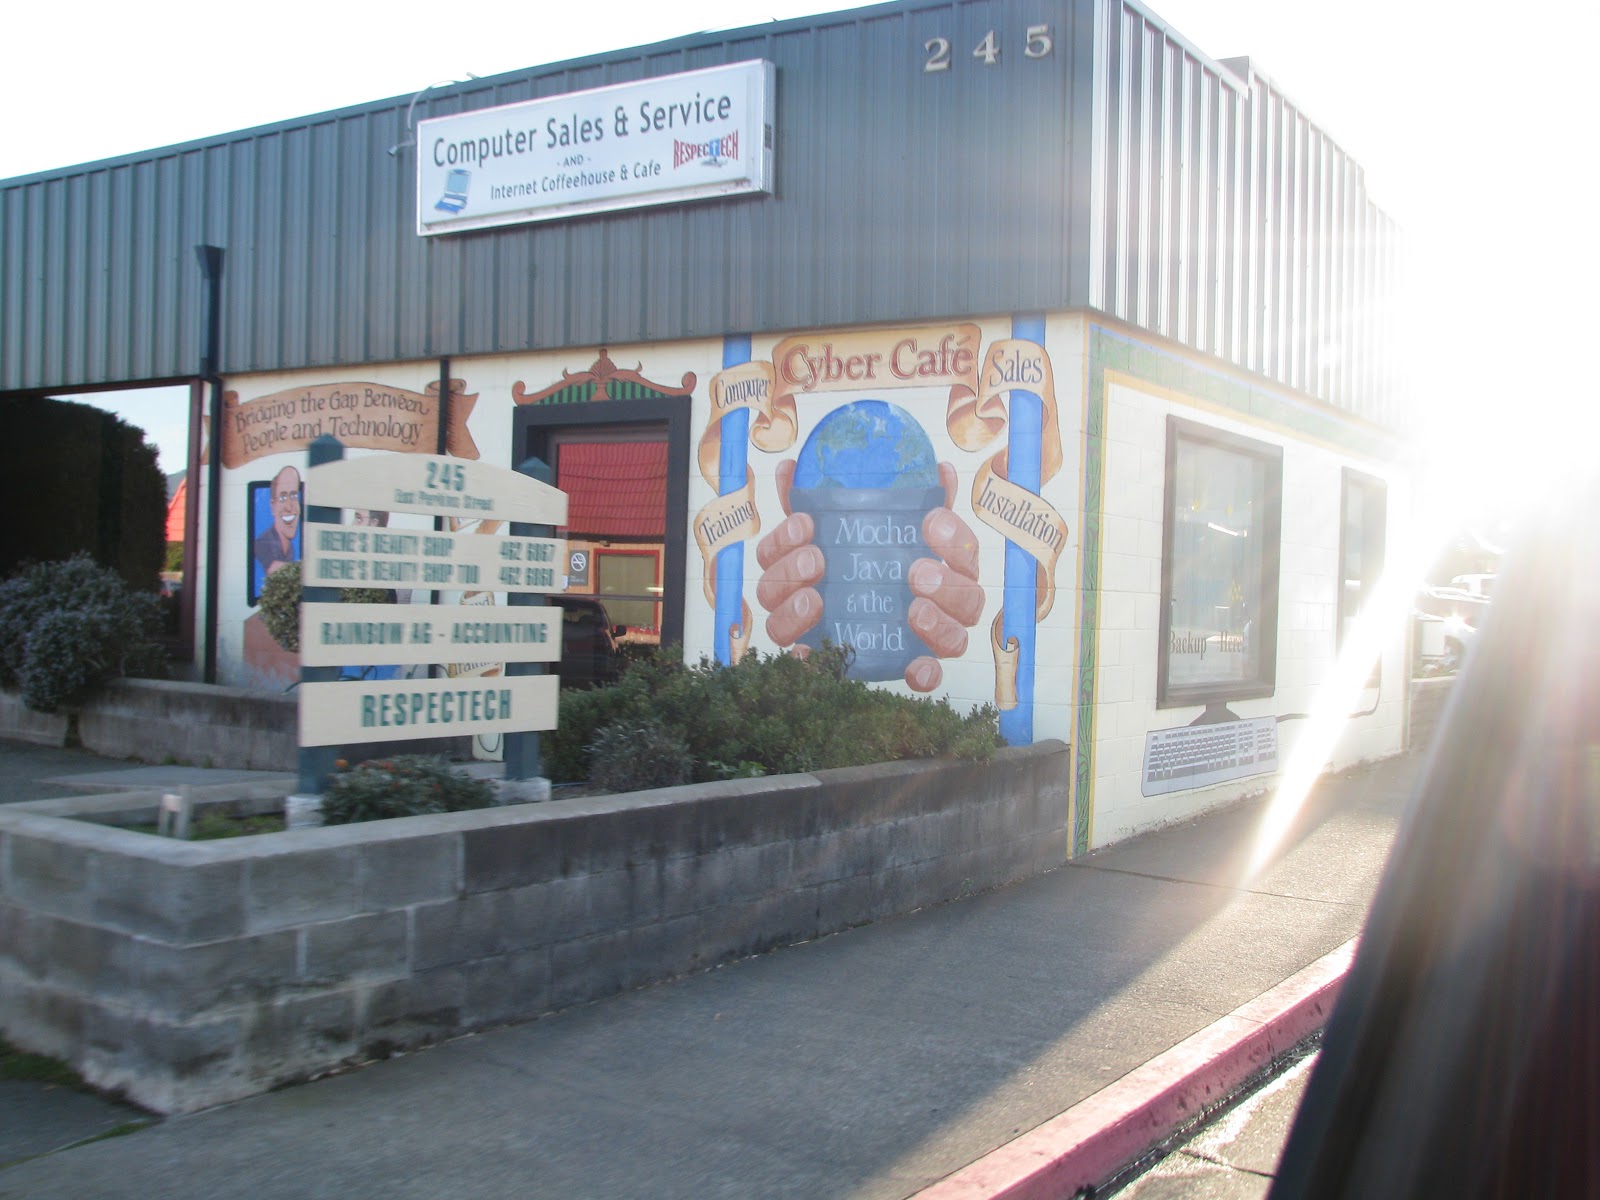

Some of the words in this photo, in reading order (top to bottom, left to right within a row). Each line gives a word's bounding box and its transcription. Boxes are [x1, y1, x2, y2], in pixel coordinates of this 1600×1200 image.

[433, 128, 537, 168] Computer
[546, 113, 604, 149] Sales
[614, 105, 630, 138] &
[639, 92, 732, 133] Service
[490, 180, 538, 201] Internet
[541, 168, 616, 193] Coffeehouse
[620, 166, 629, 180] &
[634, 160, 661, 179] Cafe
[781, 343, 883, 391] Cyber
[889, 335, 974, 380] Café
[989, 349, 1043, 387] Sales
[235, 400, 296, 433] Bridging
[300, 392, 326, 413] the
[329, 391, 359, 411] Gap
[364, 388, 429, 415] Between
[714, 377, 772, 410] Computer
[243, 421, 288, 454] People
[292, 419, 322, 439] and
[329, 414, 423, 445] Technology
[426, 461, 466, 491] 245
[699, 500, 756, 545] Training
[835, 517, 918, 545] Mocha
[976, 477, 1063, 552] Installation
[842, 553, 903, 582] Java
[862, 592, 893, 613] the
[450, 622, 548, 644] ACCOUNTING
[835, 622, 904, 651] World
[361, 689, 512, 728] RESPECTECH
